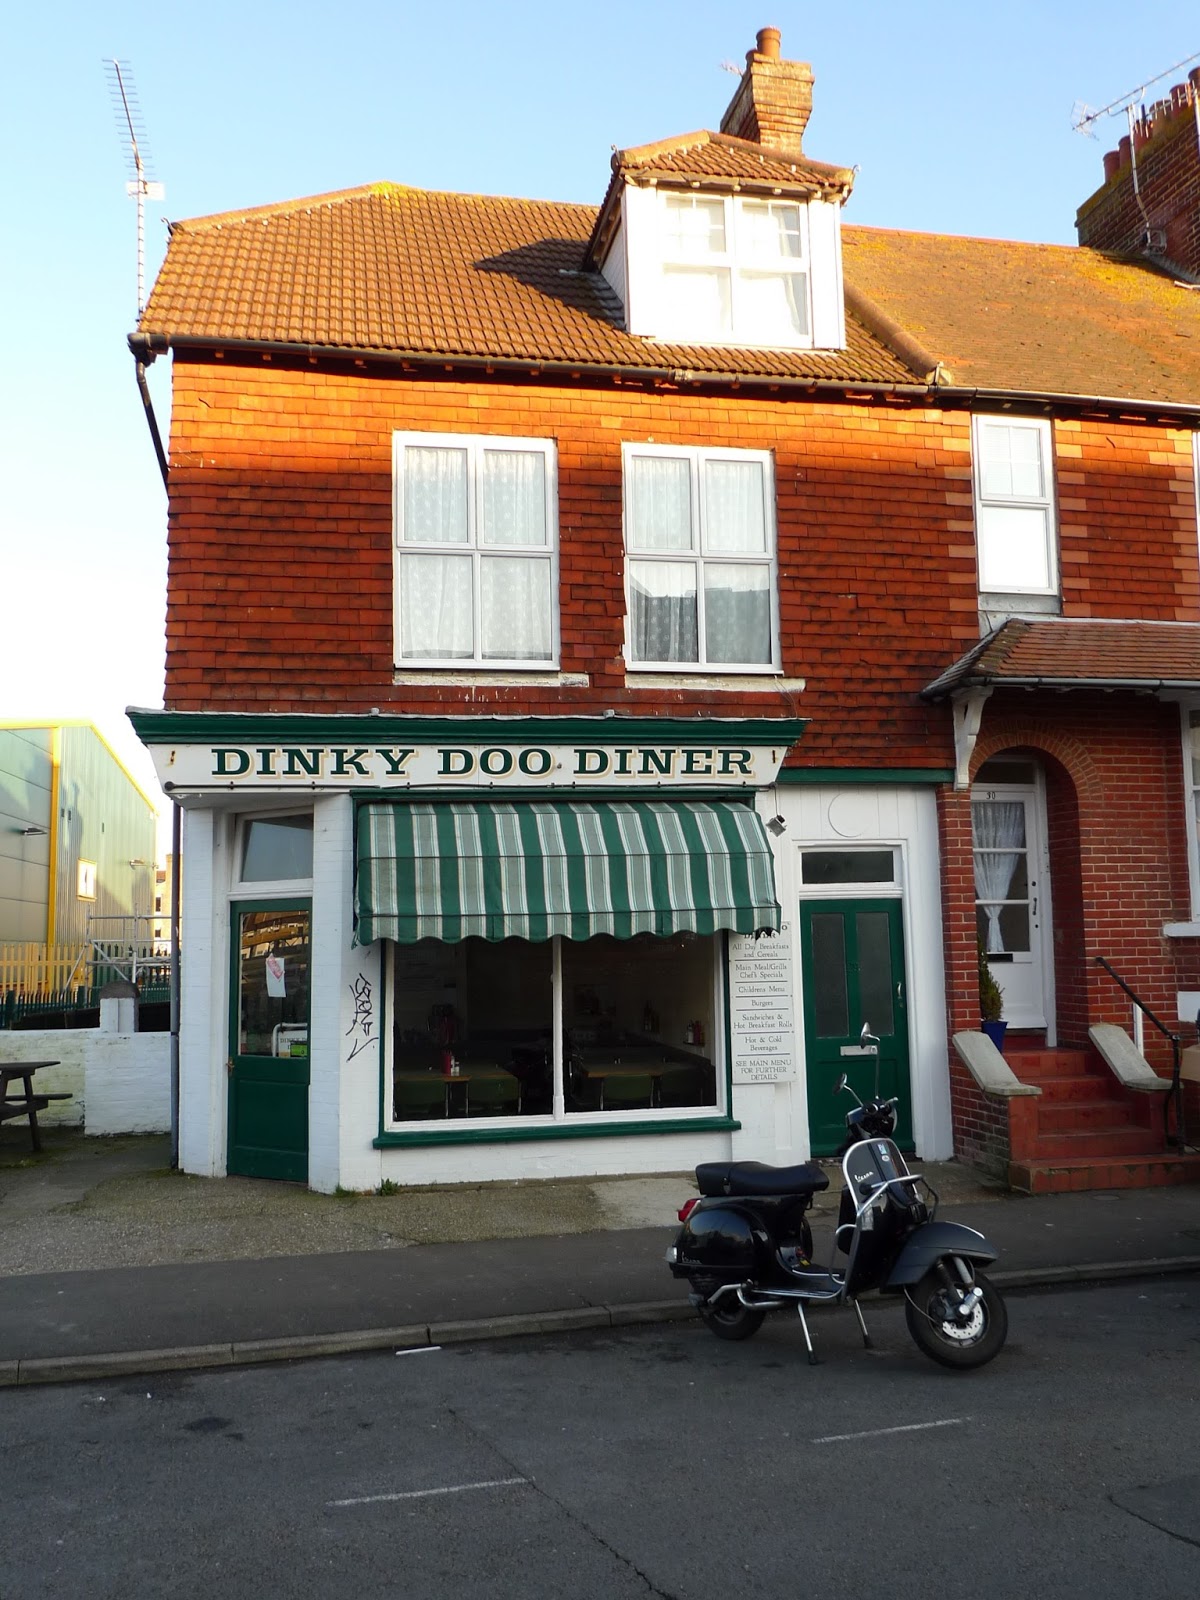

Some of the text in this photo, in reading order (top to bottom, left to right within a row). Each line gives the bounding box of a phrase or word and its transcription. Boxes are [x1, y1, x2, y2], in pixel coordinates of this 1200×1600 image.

[211, 748, 754, 777] DINKY DOO DINER
[985, 791, 996, 800] 30
[744, 943, 756, 951] Day
[759, 942, 789, 950] Breakfasts
[759, 971, 783, 979] Specials
[742, 1013, 775, 1021] Sandwiches
[750, 1044, 778, 1052] Beverages
[750, 1073, 778, 1081] DETAILS
